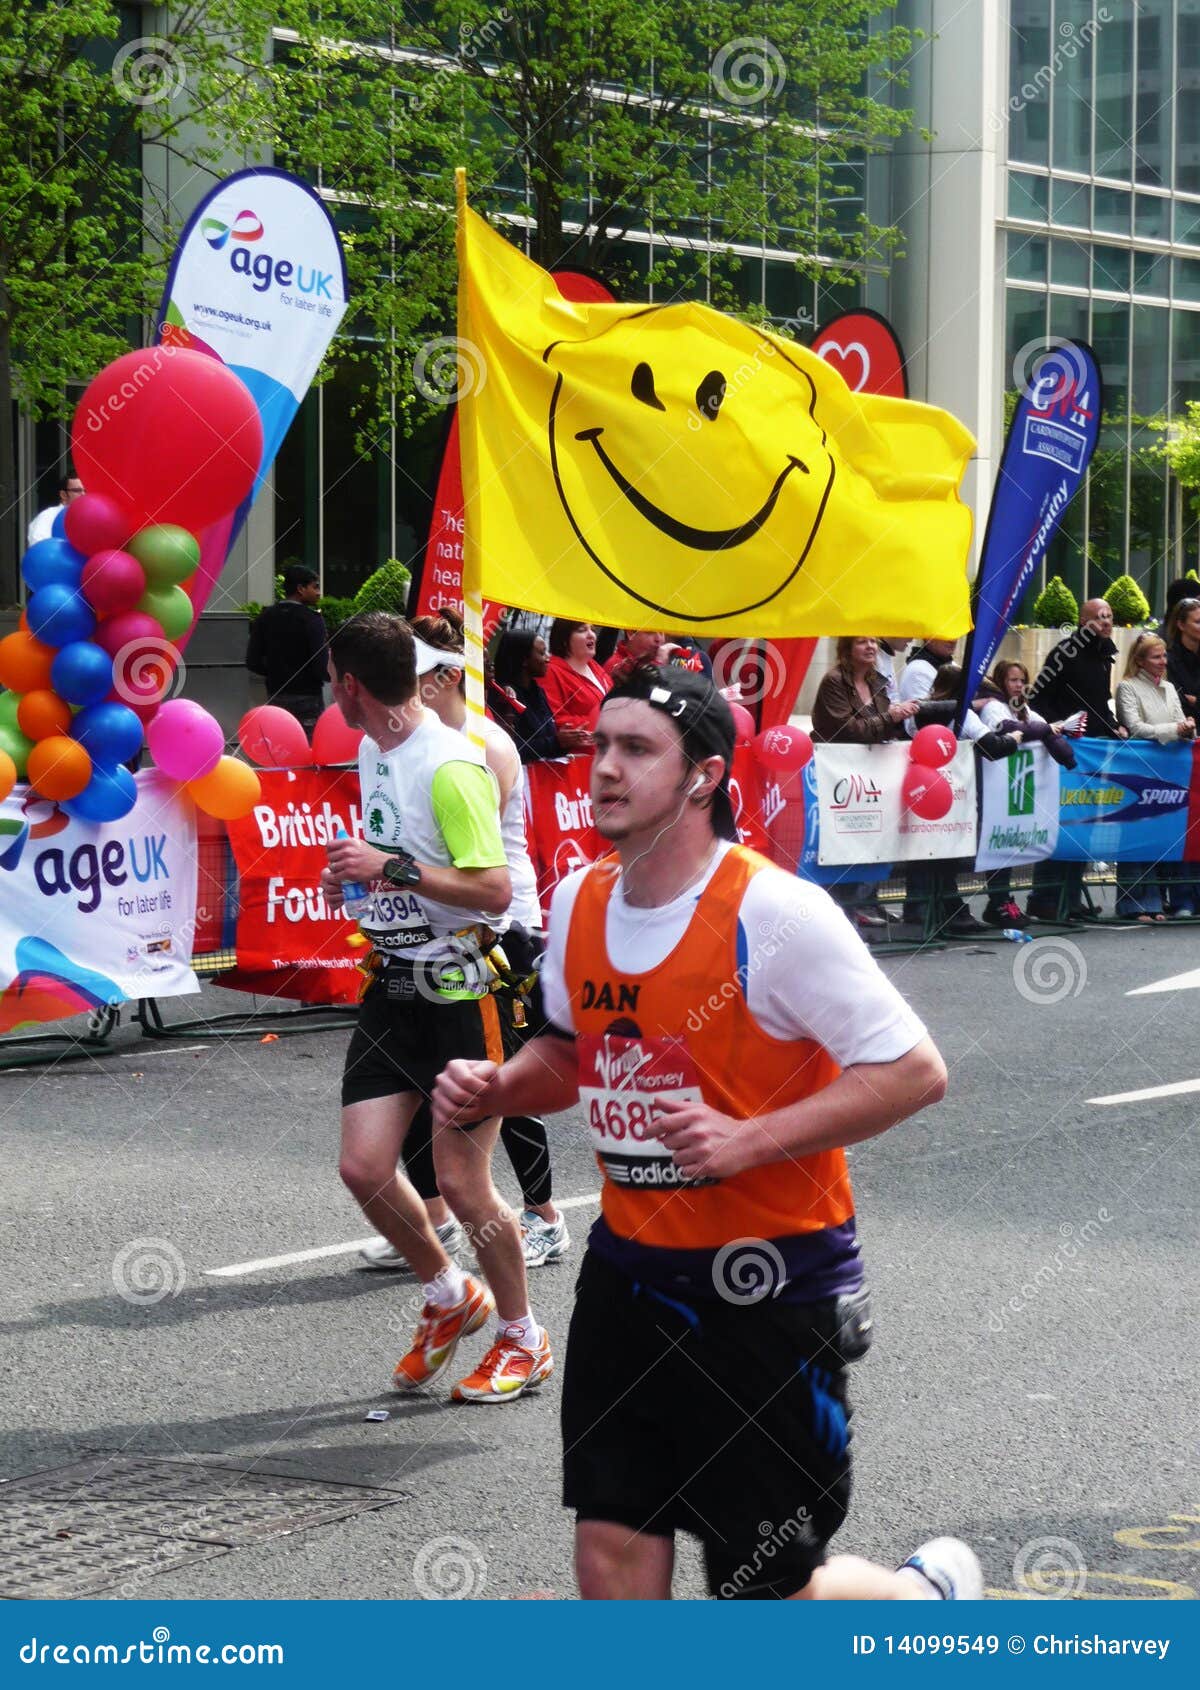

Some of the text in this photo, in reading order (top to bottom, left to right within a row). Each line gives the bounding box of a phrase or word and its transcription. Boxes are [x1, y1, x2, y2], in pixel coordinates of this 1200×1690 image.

[230, 247, 333, 300] age UK
[829, 774, 882, 809] CMA
[1137, 788, 1188, 806] SPORT
[253, 802, 347, 848] British
[989, 824, 1031, 852] Holiday
[33, 834, 170, 913] age UK
[118, 896, 134, 917] for
[136, 895, 158, 914] later
[384, 931, 430, 946] adidas
[581, 979, 641, 1013] DAN
[634, 1070, 686, 1093] money
